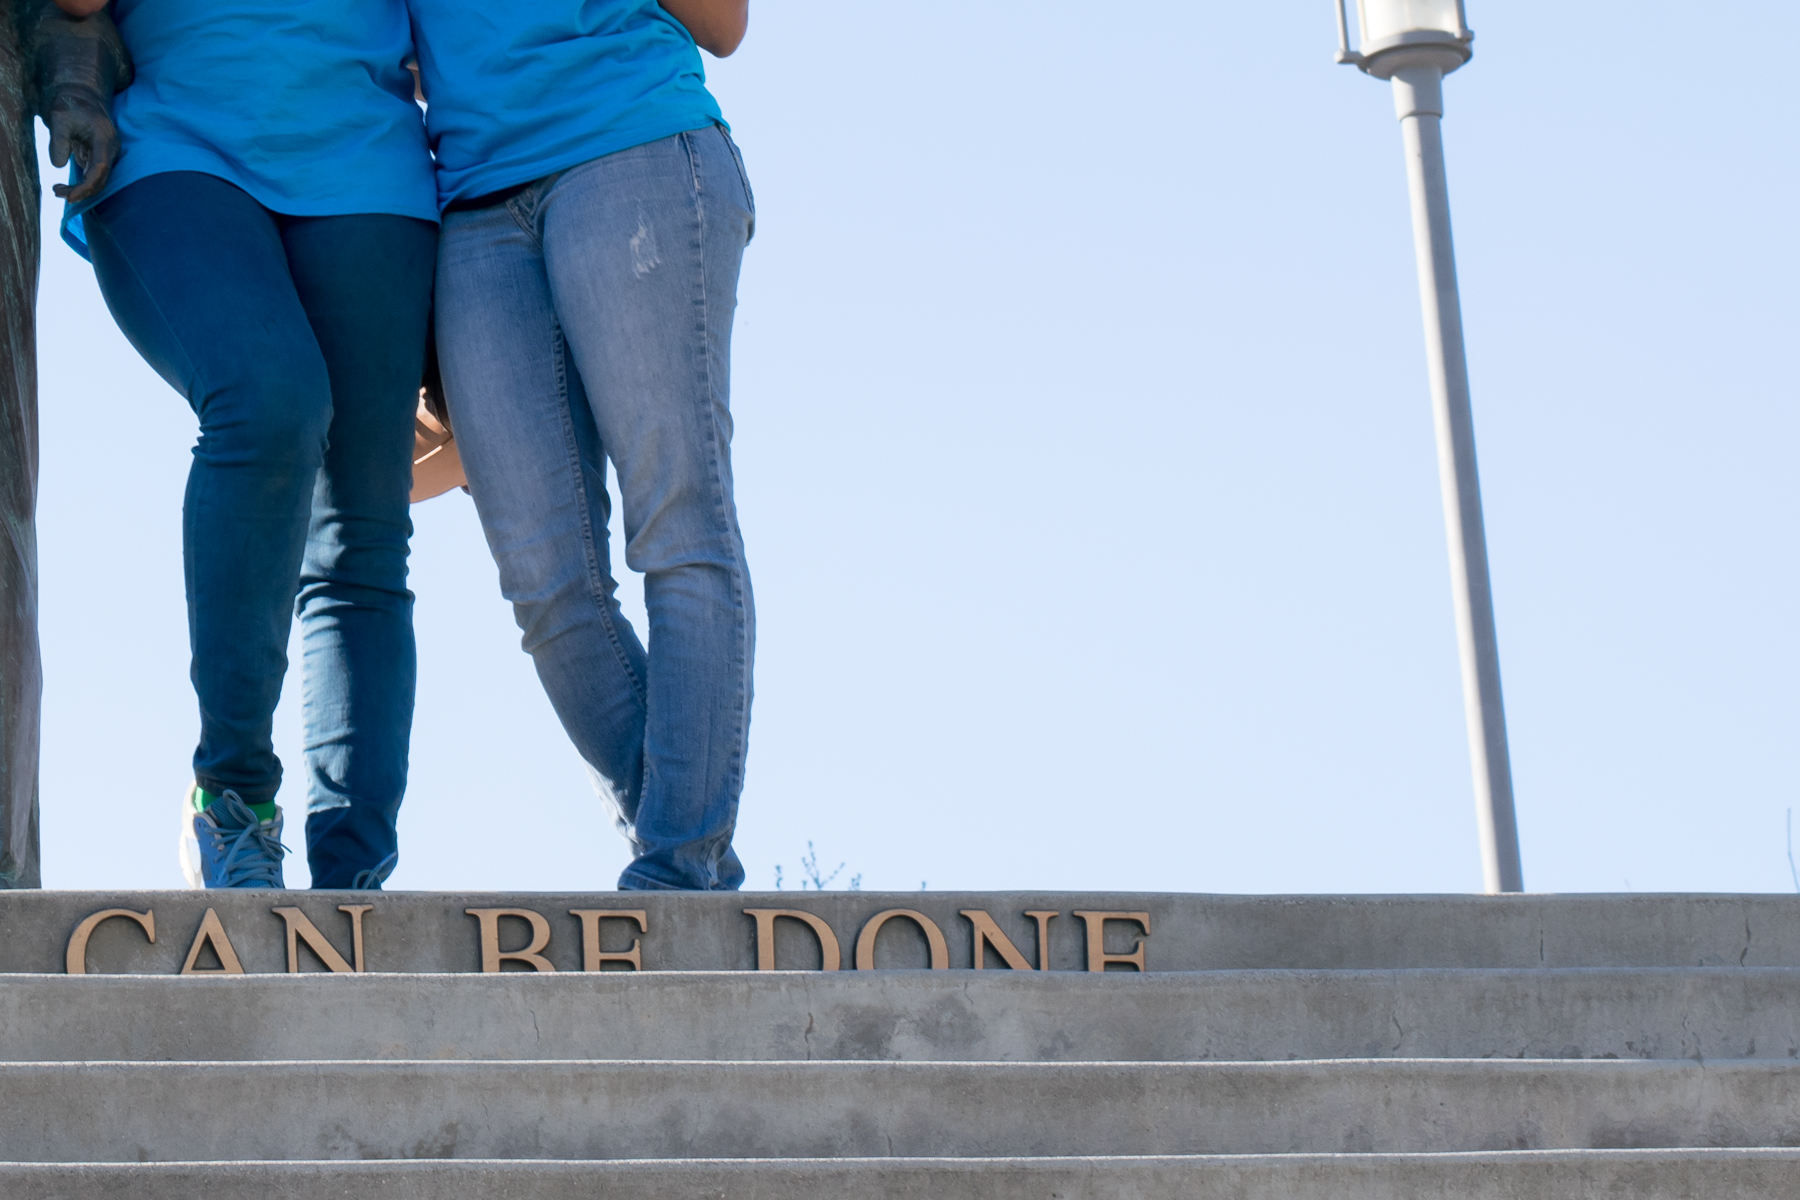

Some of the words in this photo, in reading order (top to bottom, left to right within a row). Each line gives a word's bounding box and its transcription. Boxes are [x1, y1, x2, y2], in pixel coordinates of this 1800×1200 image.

[66, 904, 374, 974] CAN
[465, 907, 648, 972] BE
[742, 908, 1151, 972] DONE
